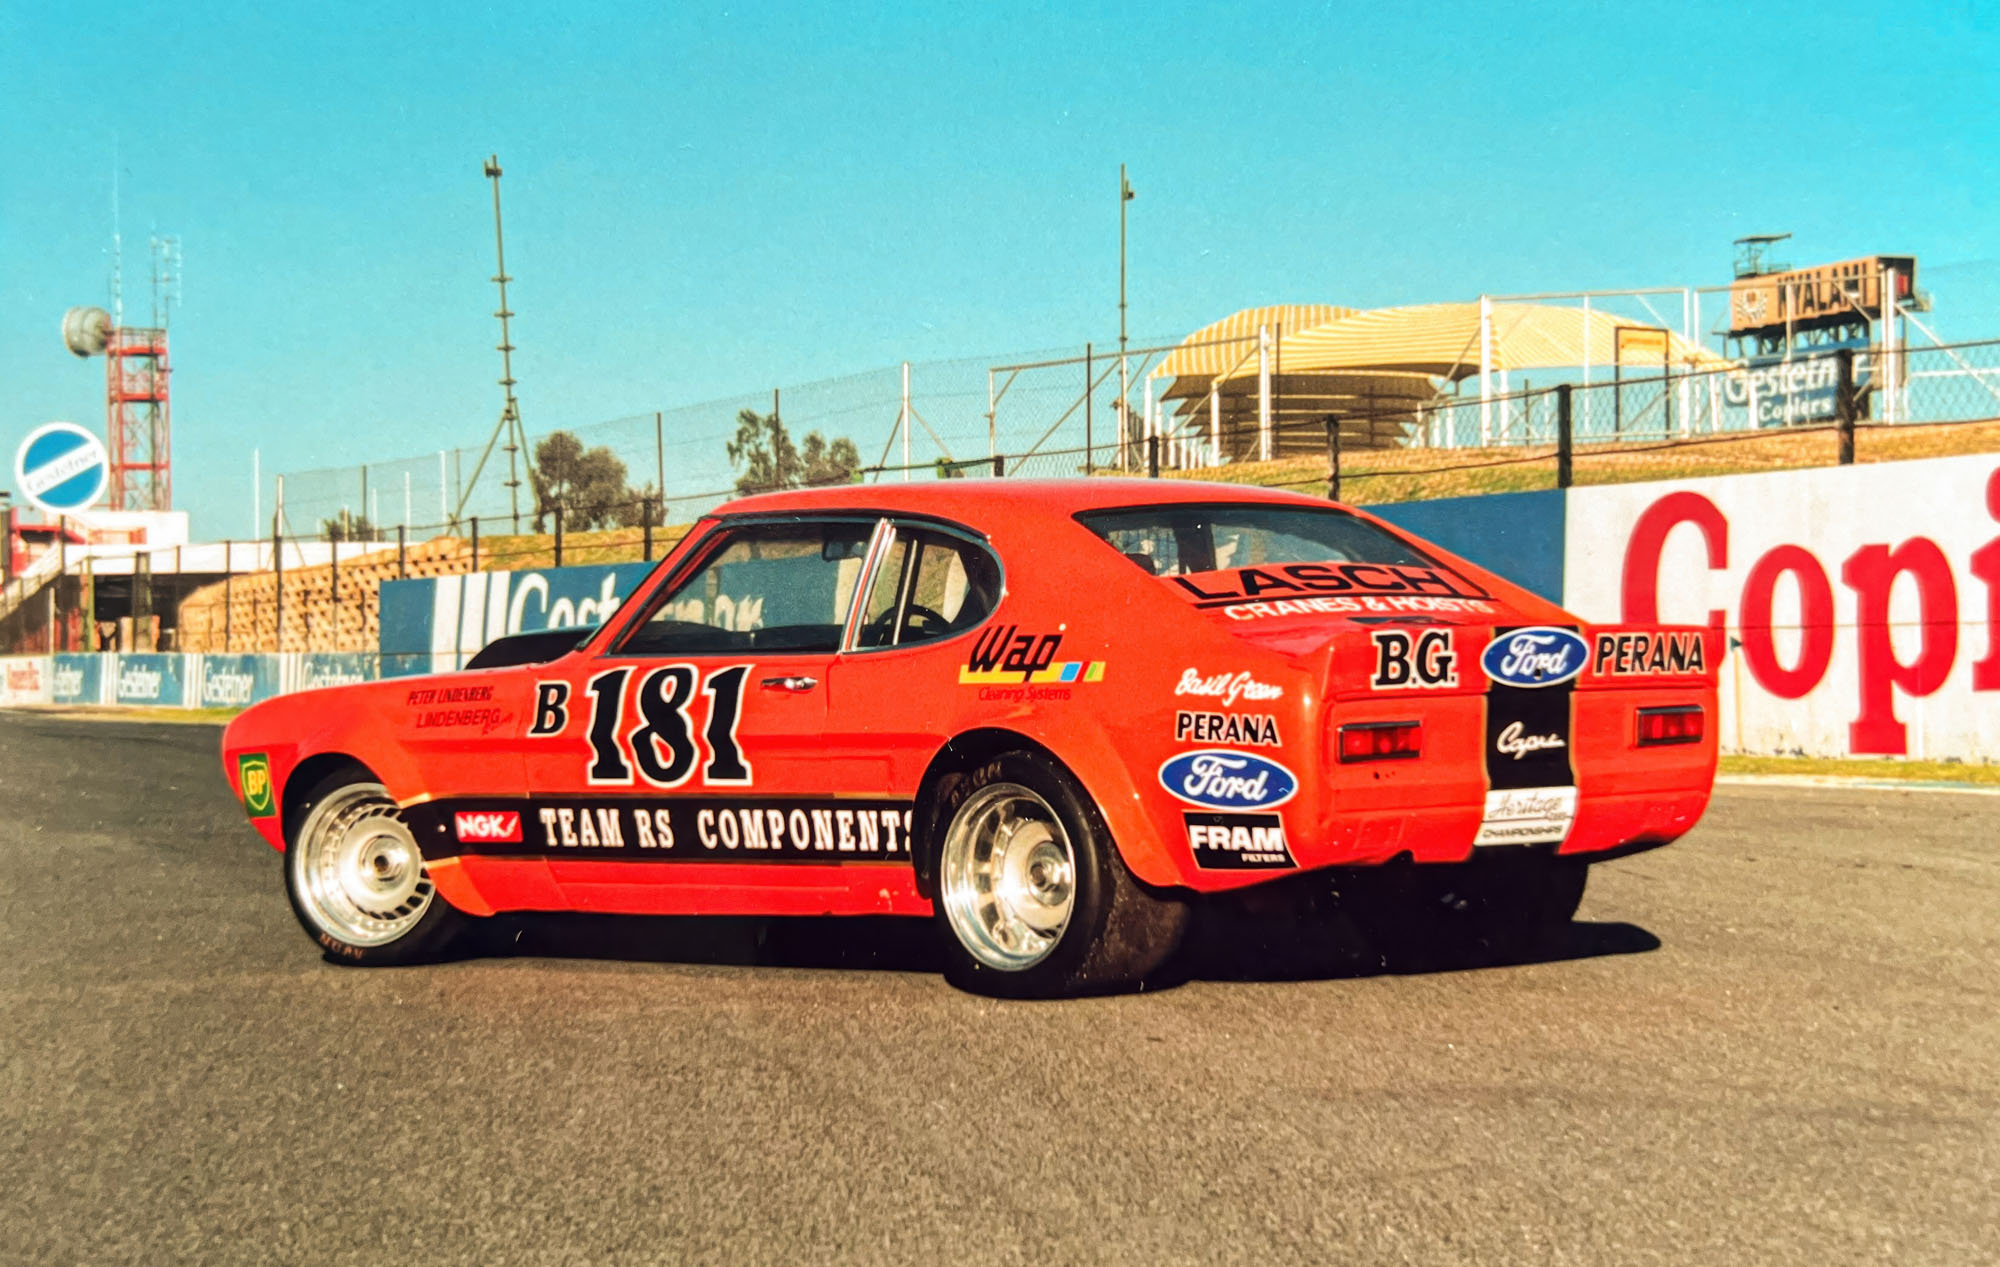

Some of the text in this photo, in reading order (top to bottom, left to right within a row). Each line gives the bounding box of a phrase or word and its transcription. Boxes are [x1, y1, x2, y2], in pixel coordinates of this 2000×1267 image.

[1173, 565, 1462, 600] LASCH
[1224, 596, 1495, 620] CRANES & HOISTS
[968, 625, 1063, 682] Wap
[1501, 634, 1570, 677] Ford
[1594, 632, 1706, 676] PERANA
[979, 687, 1071, 703] Cleaning Systems
[1175, 668, 1284, 707] Basil Green
[415, 708, 501, 729] LINDENBERG
[528, 663, 756, 787] B 181
[1176, 711, 1283, 747] PERANA
[247, 769, 266, 796] BP
[1184, 754, 1270, 801] Ford
[456, 814, 518, 839] NGK
[539, 808, 625, 847] TEAM
[634, 809, 675, 849] RS
[1189, 825, 1285, 852] FRAM
[1241, 853, 1286, 863] FILTERS
